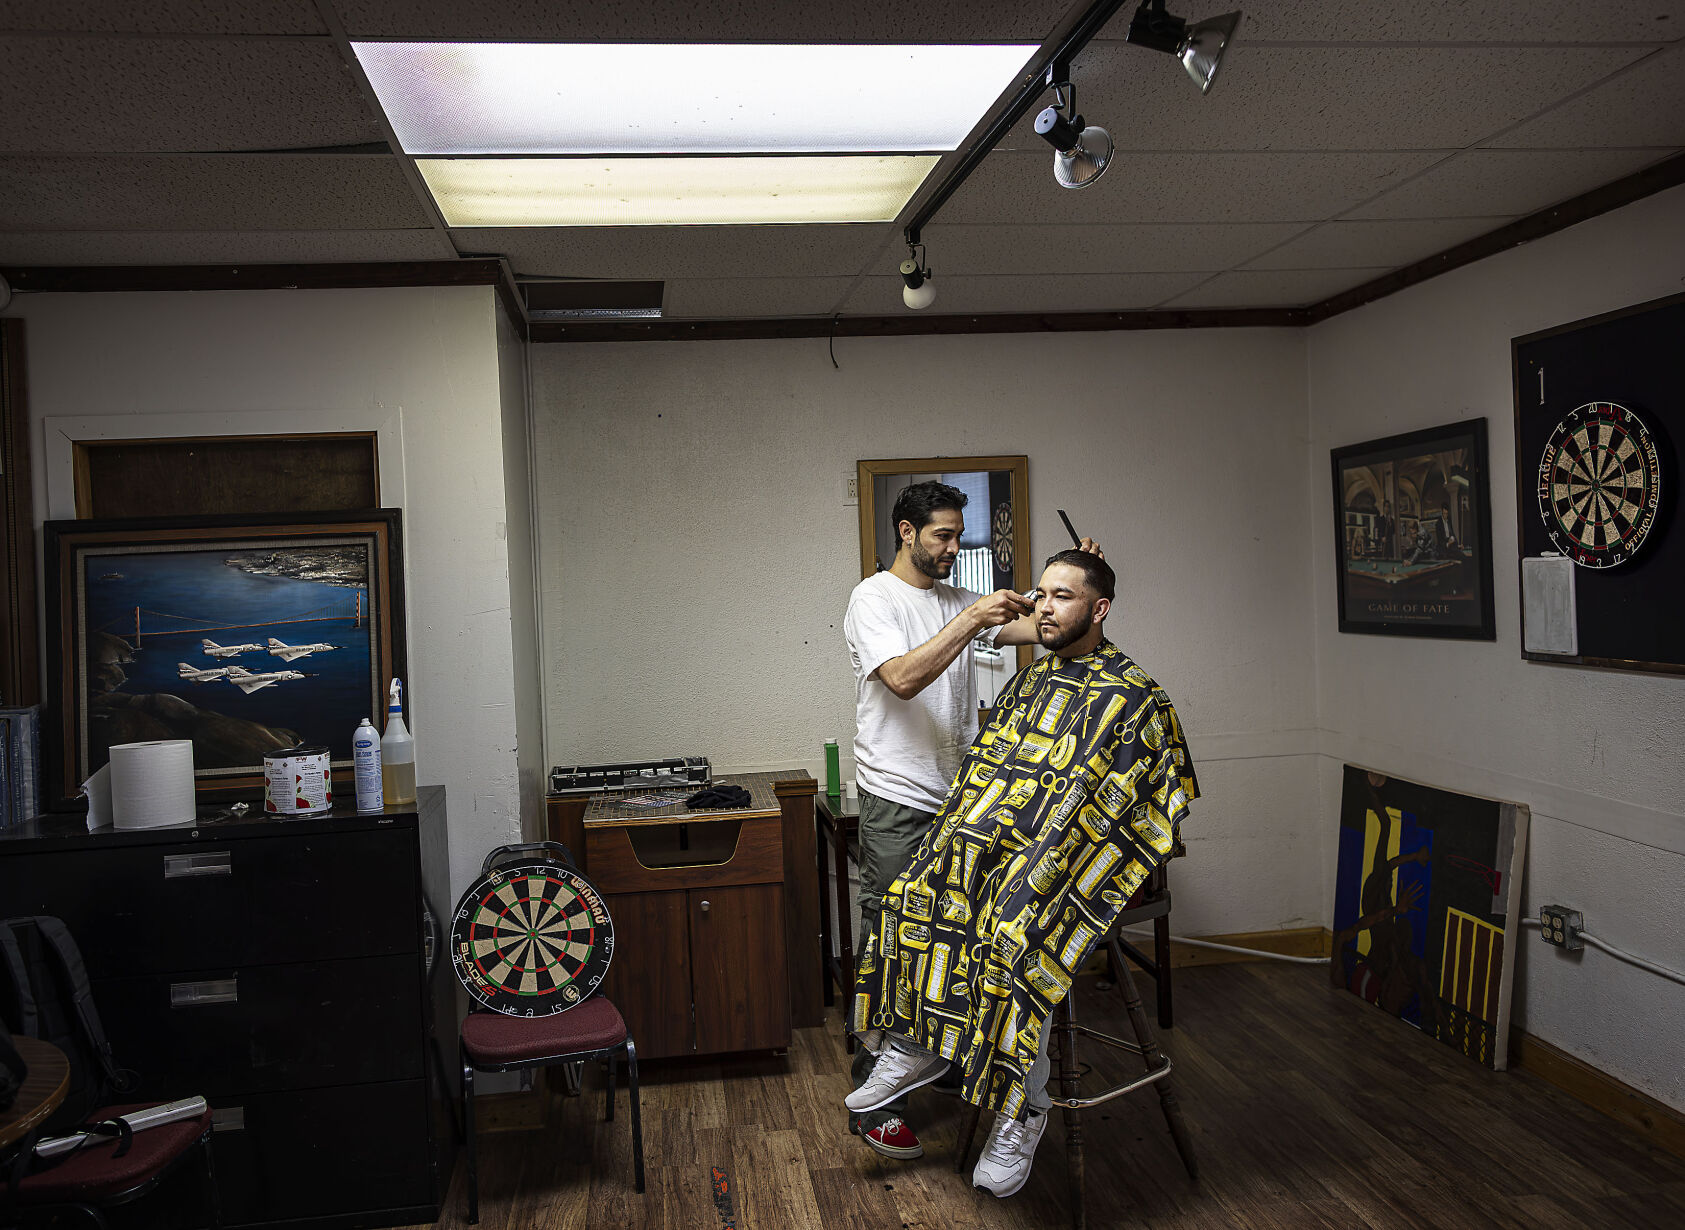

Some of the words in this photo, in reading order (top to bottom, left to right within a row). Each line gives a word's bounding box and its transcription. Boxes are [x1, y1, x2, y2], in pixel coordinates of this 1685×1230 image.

[1367, 602, 1399, 613] GAME
[1402, 603, 1418, 613] OF
[1422, 604, 1450, 614] FATE
